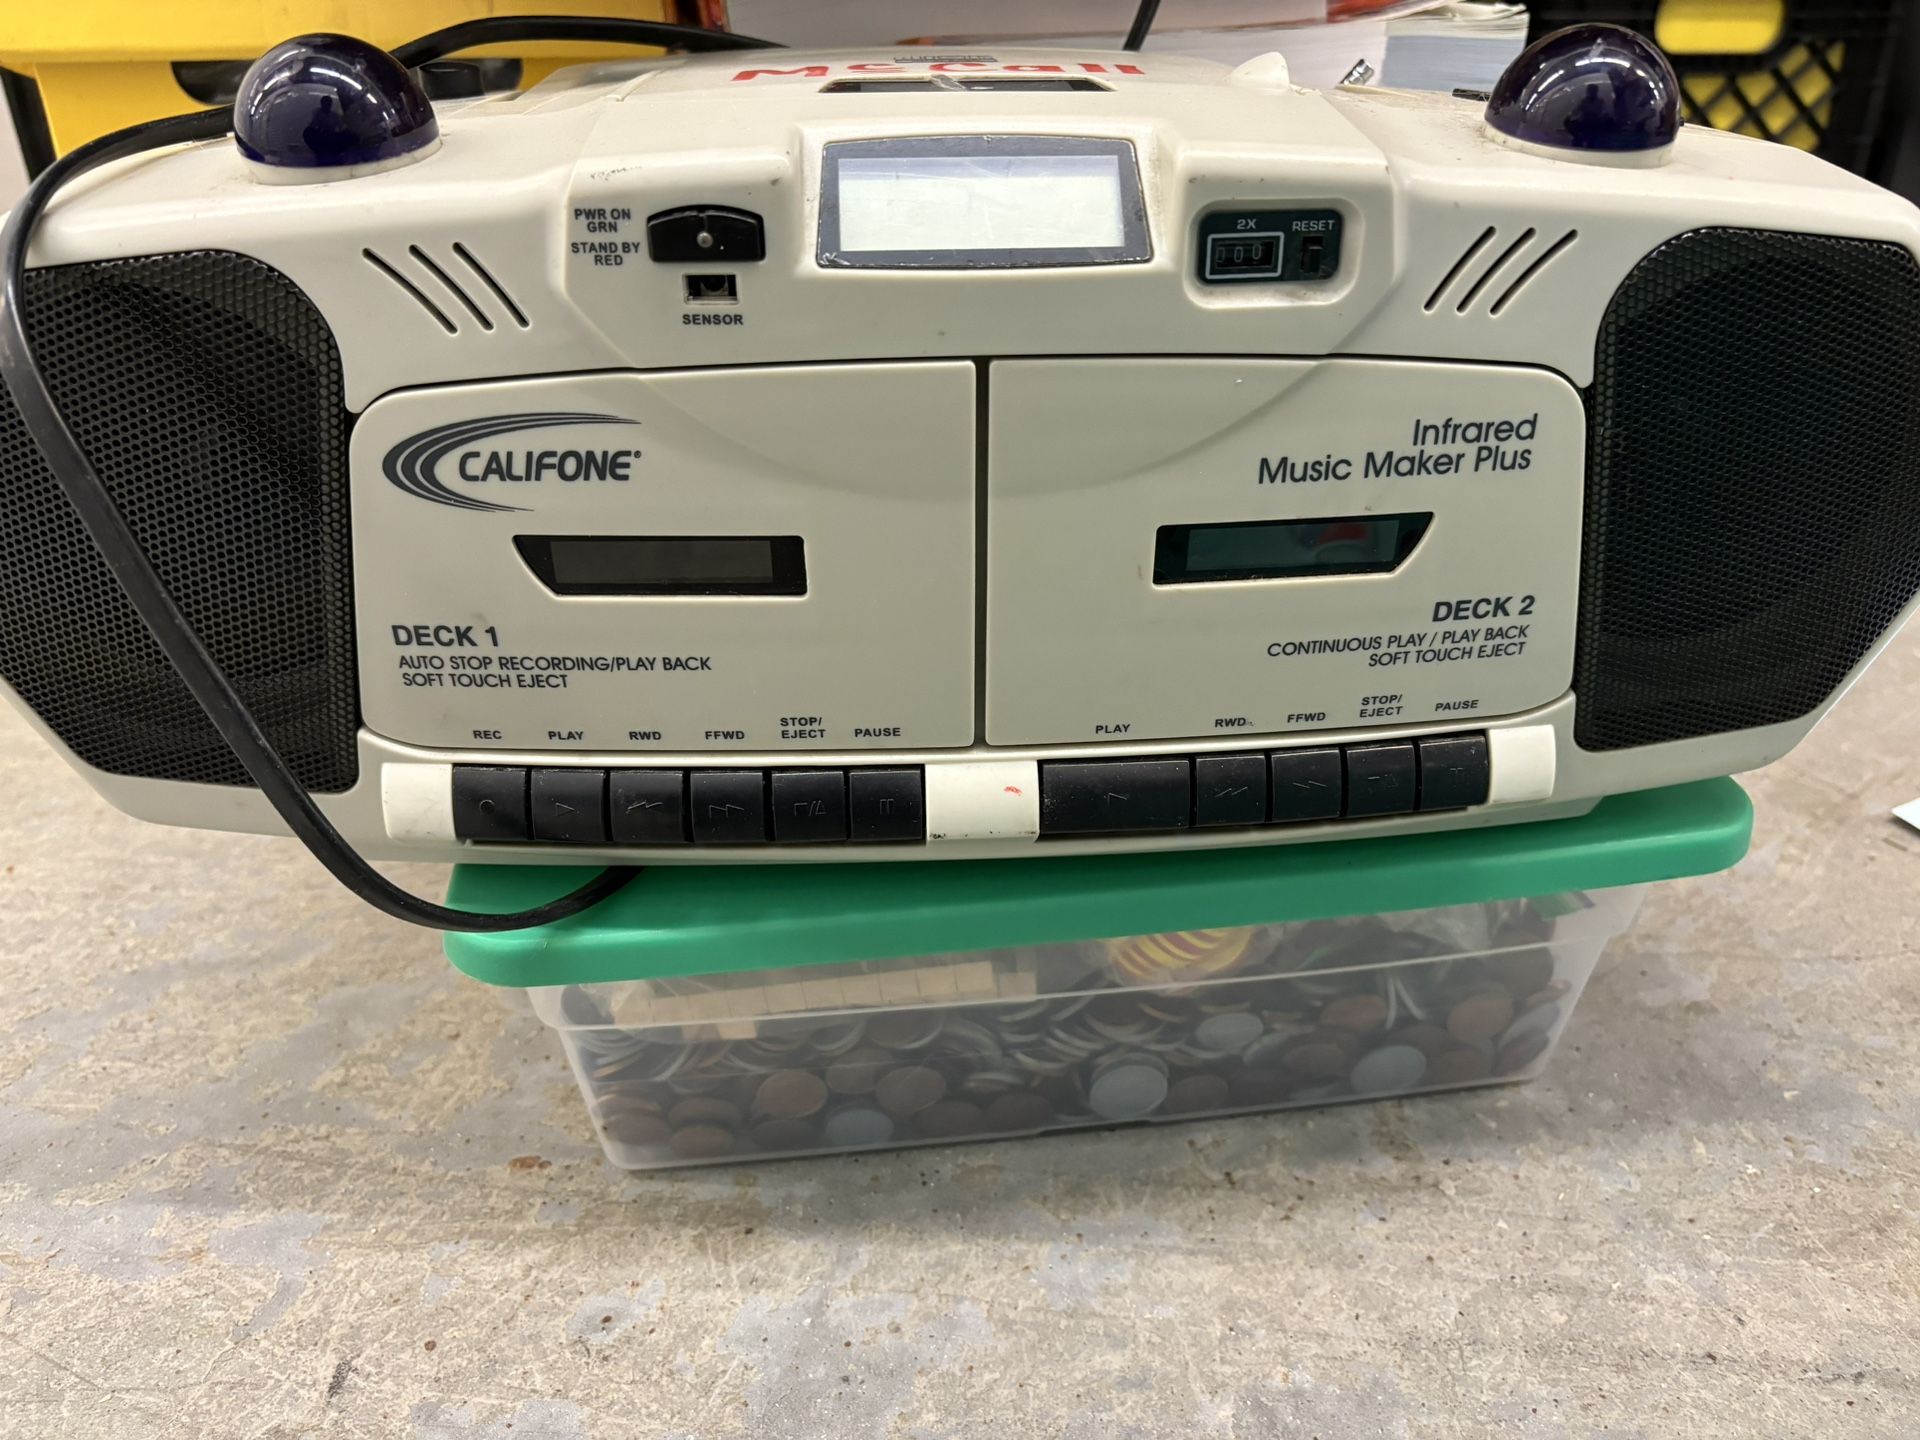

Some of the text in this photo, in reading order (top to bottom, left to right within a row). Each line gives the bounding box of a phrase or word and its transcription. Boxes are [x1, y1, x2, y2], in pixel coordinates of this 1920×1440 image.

[574, 208, 631, 220] PWR ON
[587, 221, 618, 233] GRN
[1236, 218, 1257, 230] 2X
[1292, 219, 1336, 232] RESET
[571, 242, 640, 253] STAND BY
[594, 254, 623, 266] RED
[682, 314, 744, 325] SENSOR
[1412, 413, 1538, 446] Infrared
[1258, 446, 1532, 484] Music Maker Plus
[1432, 595, 1536, 622] DECK 2
[391, 625, 499, 647] DECK 1
[1267, 636, 1383, 657] CONTINUOUS
[1387, 632, 1428, 649] PLAY
[1441, 628, 1481, 645] PLAY
[1484, 624, 1530, 642] BACK
[1368, 641, 1527, 667] SOFT TOUCH EJECT
[399, 656, 712, 672] AUTO STOP RECORDING/PLAY BACK
[402, 673, 568, 688] SOFT TOUCH EJECT
[1361, 694, 1403, 706] STOP/
[1434, 699, 1479, 711] PAUSE
[1287, 711, 1327, 724] FFWD
[1358, 705, 1403, 718] EJECT
[780, 717, 823, 728] STOP/
[1214, 717, 1247, 728] RWD
[473, 730, 502, 740] REC
[781, 728, 827, 740] EJECT
[854, 727, 901, 738] PAUSE
[1095, 723, 1131, 735] PLAY
[548, 730, 584, 741] PLAY
[629, 730, 662, 741] RWD
[705, 730, 745, 741] FFWD
